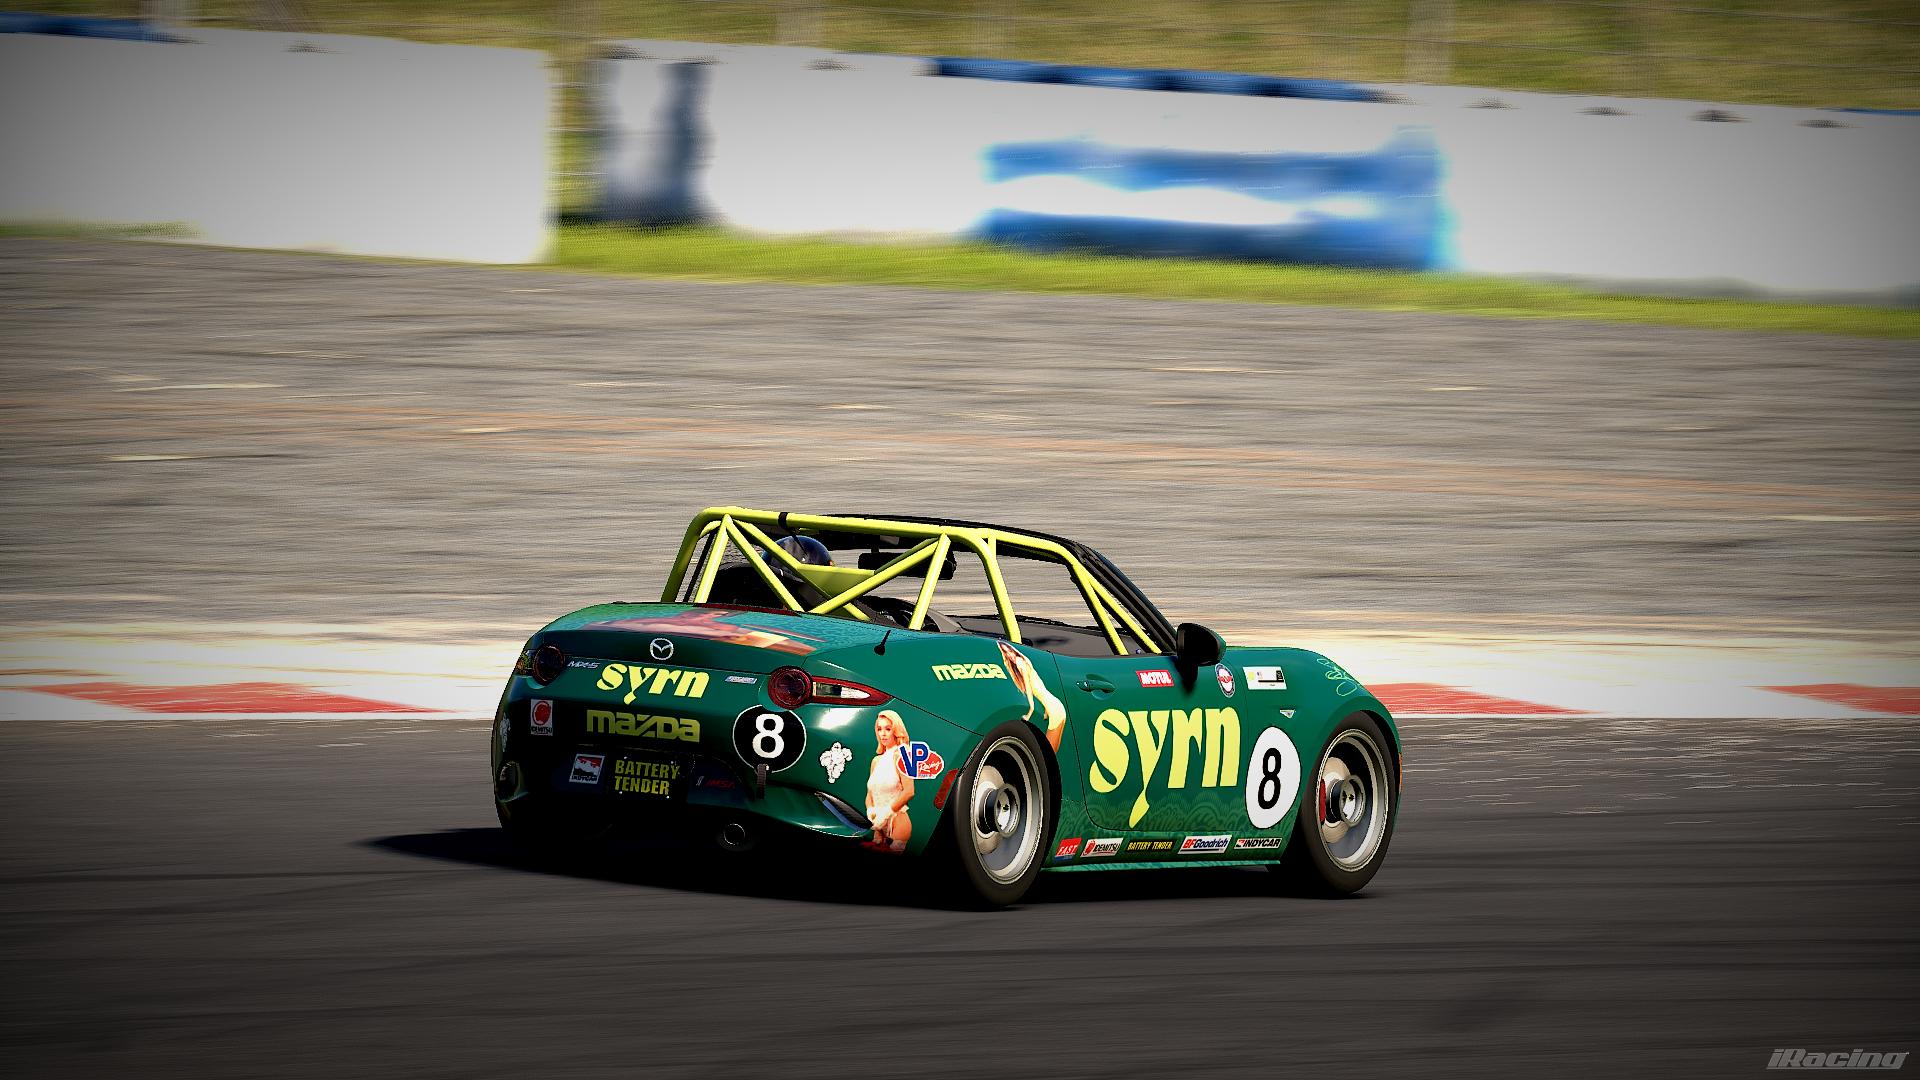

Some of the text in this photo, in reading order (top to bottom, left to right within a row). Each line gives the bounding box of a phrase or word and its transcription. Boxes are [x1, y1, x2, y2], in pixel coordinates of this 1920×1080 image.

[932, 663, 1008, 681] mazda
[1140, 671, 1173, 685] MOTUL
[596, 663, 710, 705] syrn
[586, 709, 701, 741] mazda
[752, 713, 785, 759] 8
[614, 759, 680, 780] BATTERY
[899, 743, 929, 778] VP
[1089, 706, 1241, 829] syrn
[614, 775, 670, 795] TENDER
[1257, 747, 1282, 810] 8
[1057, 844, 1079, 856] FAST
[1127, 841, 1173, 851] BATTERY TENDER
[1183, 838, 1229, 849] BFGoodrich
[1243, 838, 1281, 848] INDYCAR
